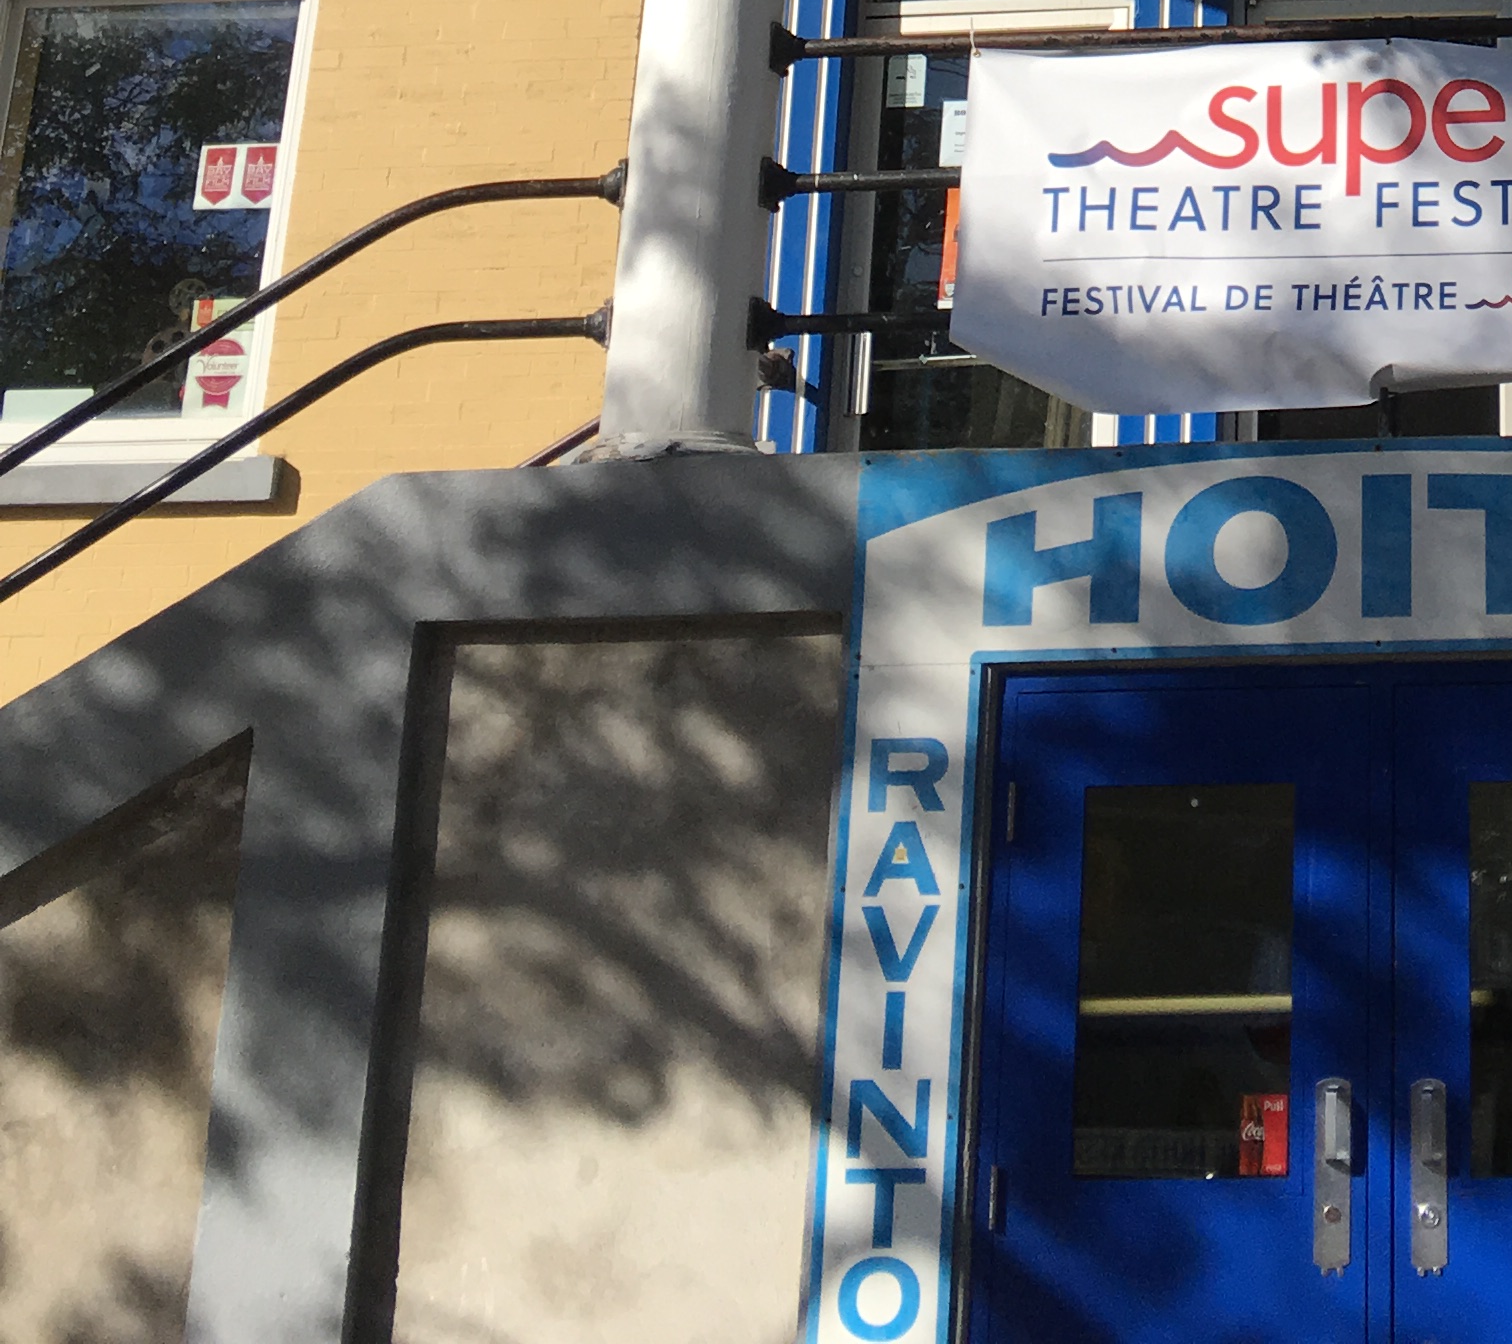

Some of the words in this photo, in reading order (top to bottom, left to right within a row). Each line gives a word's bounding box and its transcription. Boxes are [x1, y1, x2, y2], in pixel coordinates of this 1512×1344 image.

[1043, 183, 1324, 233] THEATRE
[1041, 282, 1207, 317] FESTIVAL
[1225, 281, 1273, 313] DE
[1292, 273, 1459, 314] THÉÂTRE
[196, 355, 239, 374] Volunteer
[837, 737, 949, 1343] RAVINTO
[1263, 1099, 1284, 1112] Pull
